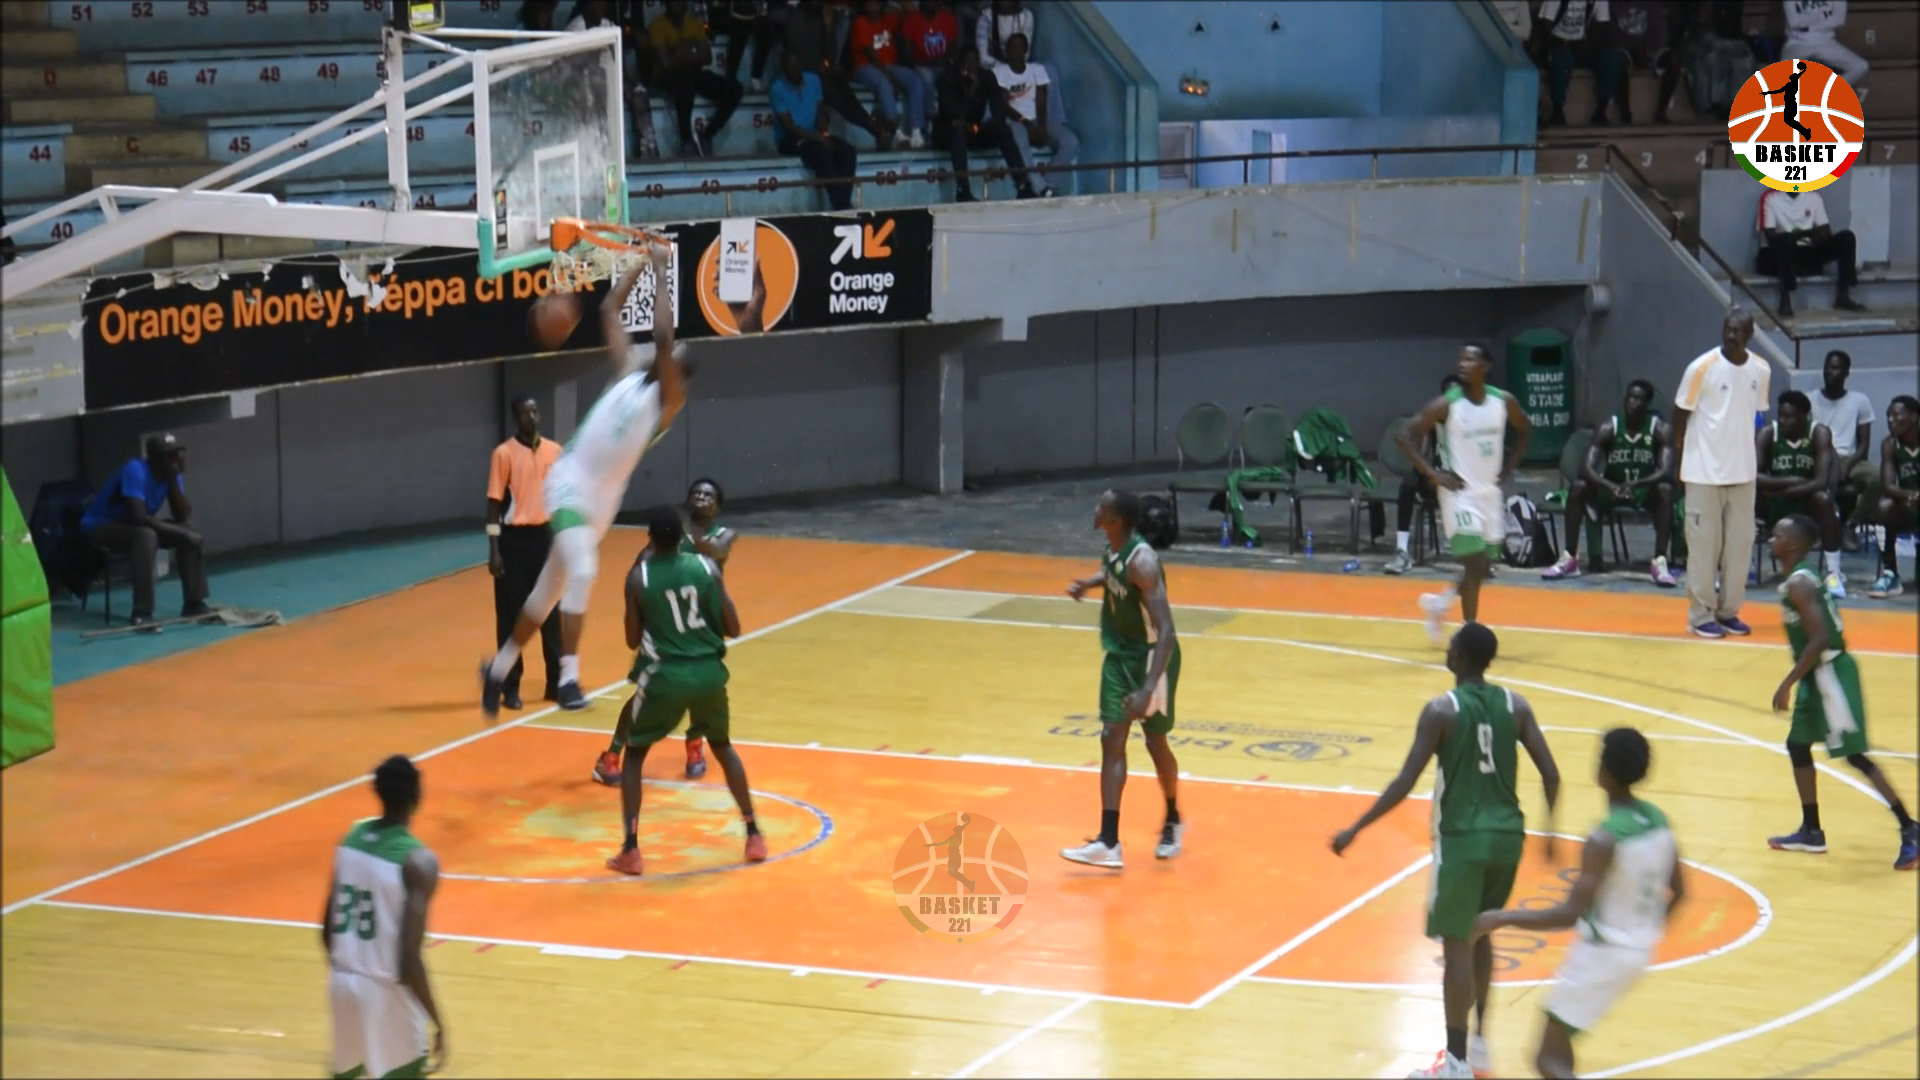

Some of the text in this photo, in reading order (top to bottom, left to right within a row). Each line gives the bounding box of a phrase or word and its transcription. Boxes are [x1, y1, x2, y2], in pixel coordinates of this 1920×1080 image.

[71, 4, 93, 22] 51
[131, 2, 153, 18] 52
[187, 1, 209, 17] 53
[246, 1, 268, 14] 54
[146, 70, 168, 86] 46
[196, 68, 217, 85] 47
[259, 66, 280, 82] 48
[317, 62, 339, 79] 49
[753, 113, 774, 128] 54
[29, 144, 52, 162] 44
[126, 136, 140, 153] C
[229, 136, 251, 153] 45
[1884, 145, 1895, 160] 7
[1576, 153, 1588, 169] 2
[1642, 152, 1653, 167] 3
[51, 221, 73, 239] 40
[724, 266, 747, 274] Money
[725, 257, 749, 267] Orange
[829, 271, 895, 292] Orange
[829, 293, 889, 314] Money
[99, 301, 224, 345] Orange
[230, 286, 355, 329] Money,
[1529, 393, 1564, 408] STADE
[665, 584, 707, 634] 12
[1477, 723, 1496, 775] 9
[331, 883, 377, 942] 33
